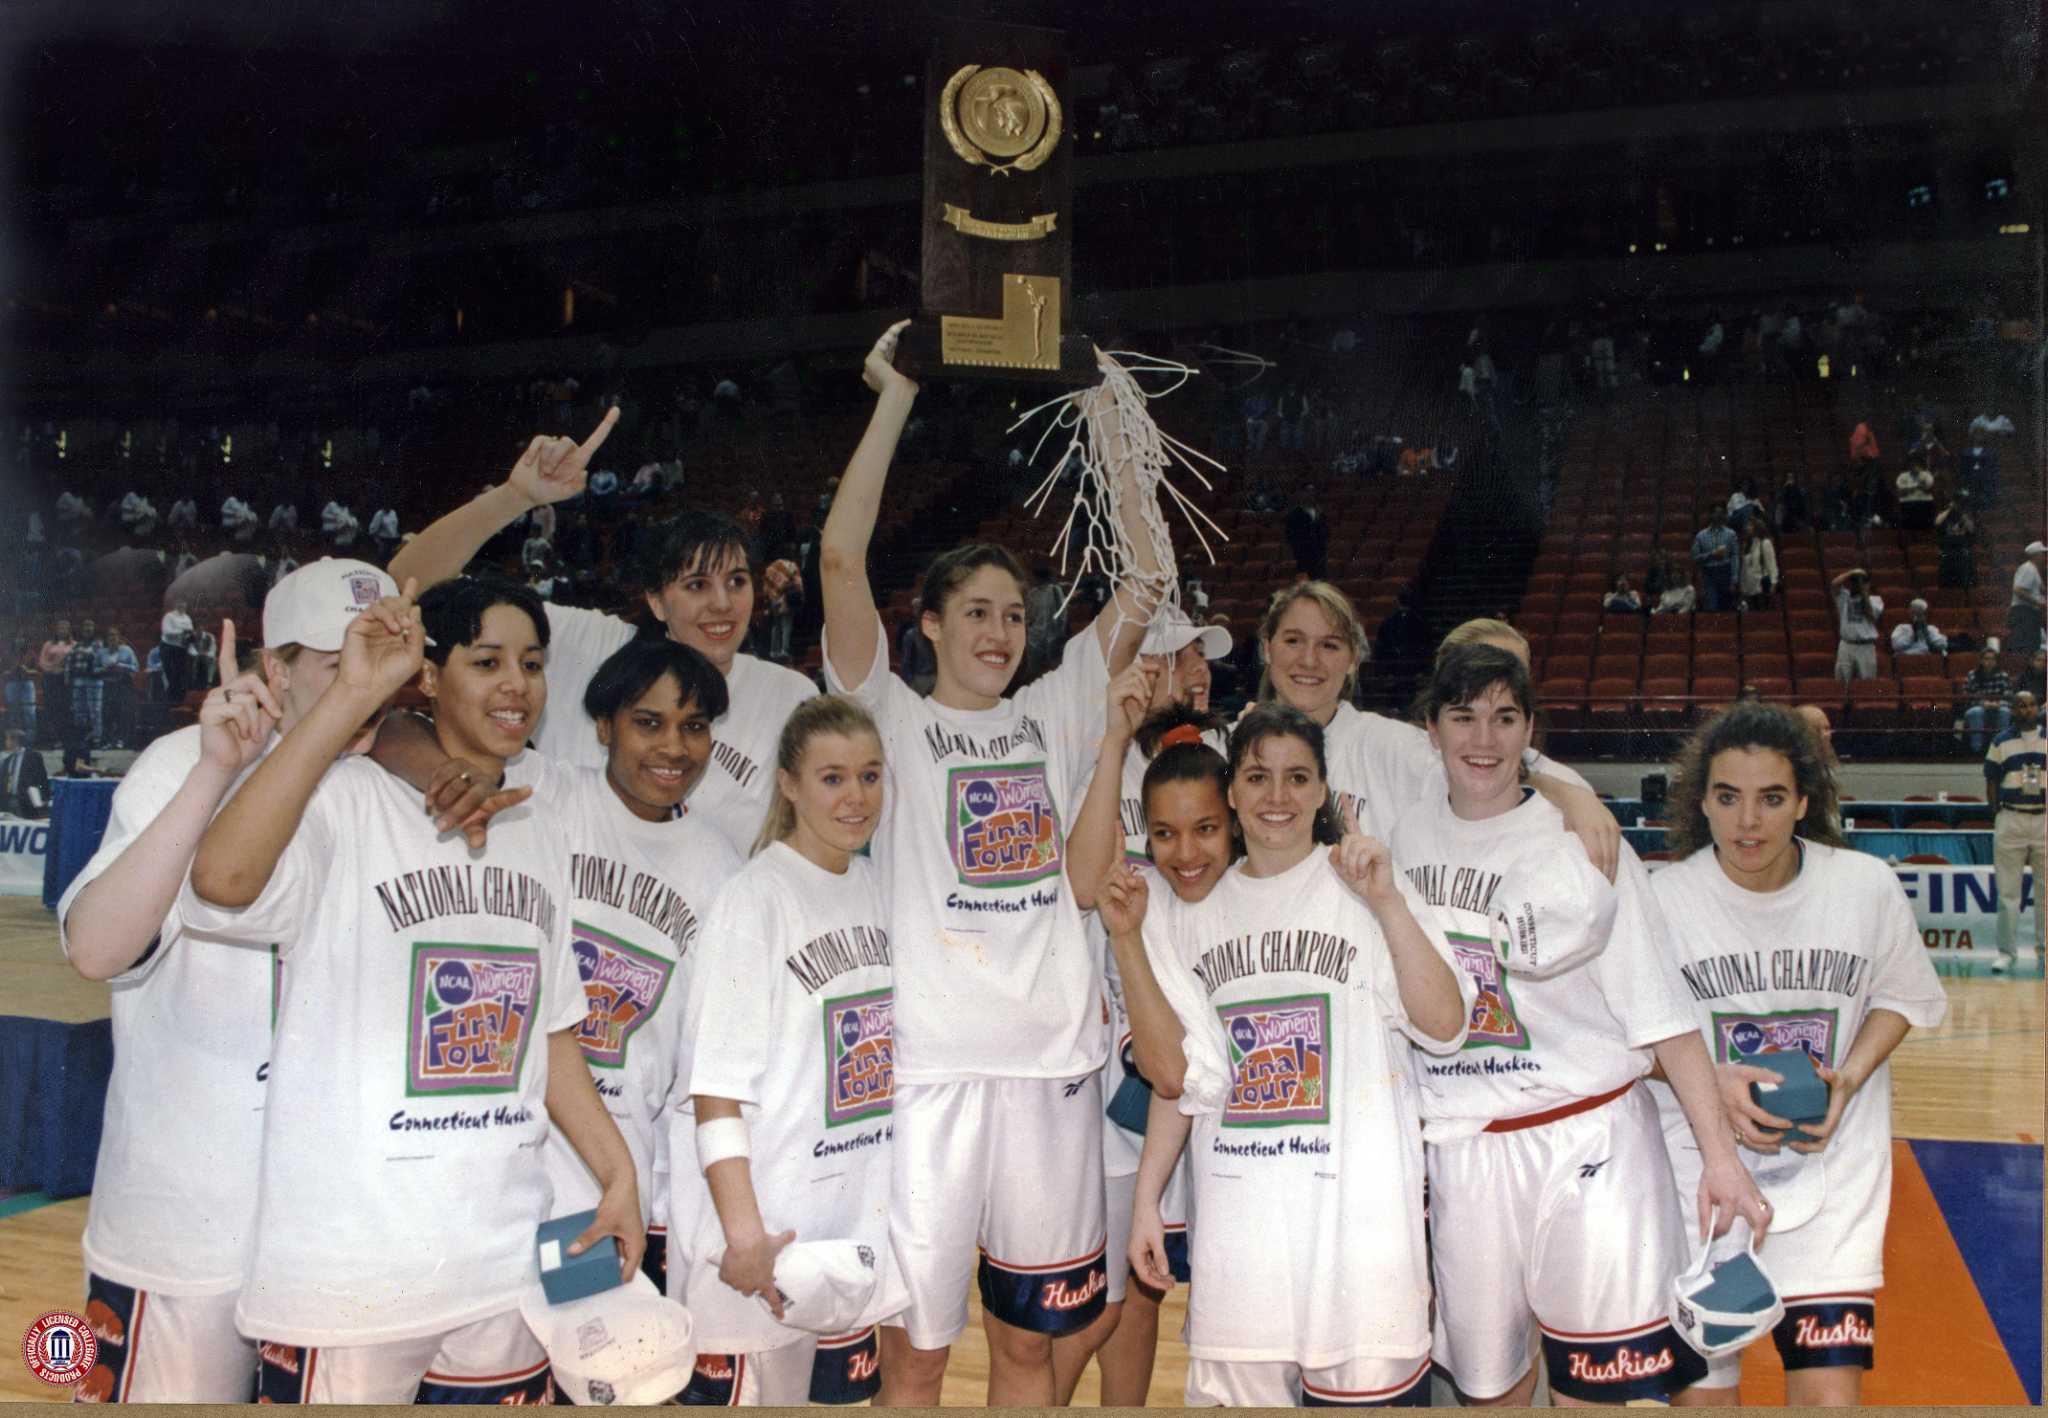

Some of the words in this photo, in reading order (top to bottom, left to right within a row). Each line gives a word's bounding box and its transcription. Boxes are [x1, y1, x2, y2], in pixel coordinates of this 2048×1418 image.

[969, 792, 995, 804] NCAA
[964, 802, 1041, 867] Final
[375, 865, 478, 933] NATIONAL
[946, 893, 1027, 912] Connecticut
[1919, 928, 1973, 950] OTA
[1260, 929, 1357, 985] CHAMPIONS
[439, 974, 472, 990] NCAA
[474, 968, 531, 999] Women's
[1681, 951, 1766, 1001] NATIONAL
[1772, 949, 1868, 998] CHAMPIONS
[1258, 1012, 1316, 1043] Women's
[1484, 1055, 1541, 1075] Huskies
[389, 1110, 490, 1131] Connecticut
[813, 1128, 881, 1157] Connecticut
[1569, 1347, 1673, 1381] Huskies
